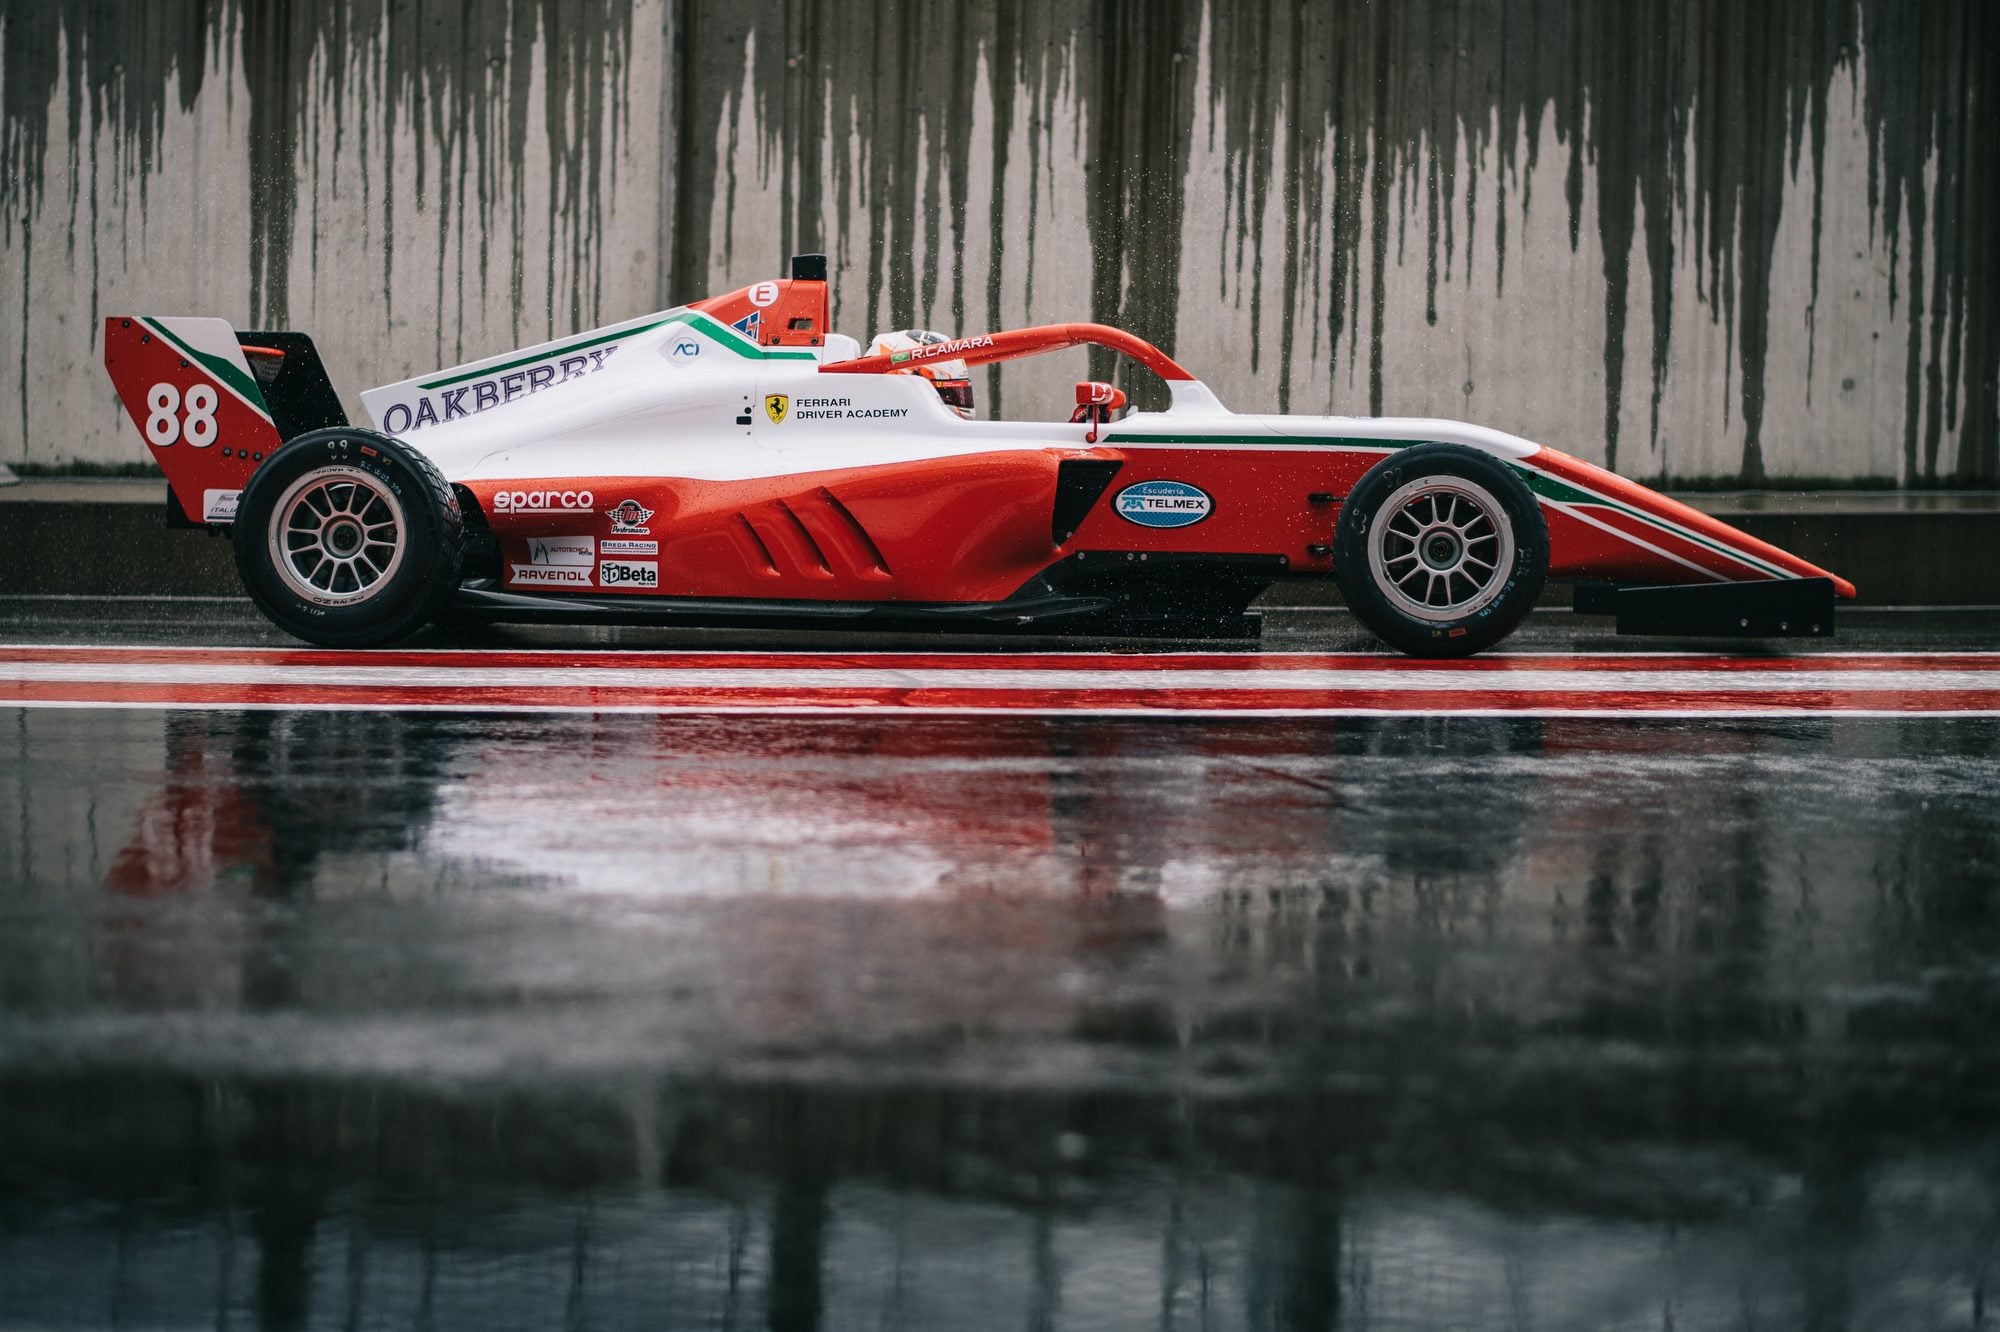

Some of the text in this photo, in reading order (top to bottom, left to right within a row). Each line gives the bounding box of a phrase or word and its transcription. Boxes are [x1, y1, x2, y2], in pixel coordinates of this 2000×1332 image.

[755, 284, 771, 302] E
[672, 343, 700, 356] ACI
[911, 336, 994, 360] R.CAMARA
[384, 346, 618, 436] OAKBERRY
[796, 398, 851, 407] FERRARI
[145, 382, 219, 448] 88
[796, 408, 908, 419] DRIVER ACADEMY
[493, 490, 594, 514] sparco
[1146, 498, 1205, 510] TELMEX
[518, 570, 586, 581] RAVENOL
[619, 566, 657, 582] Beta
